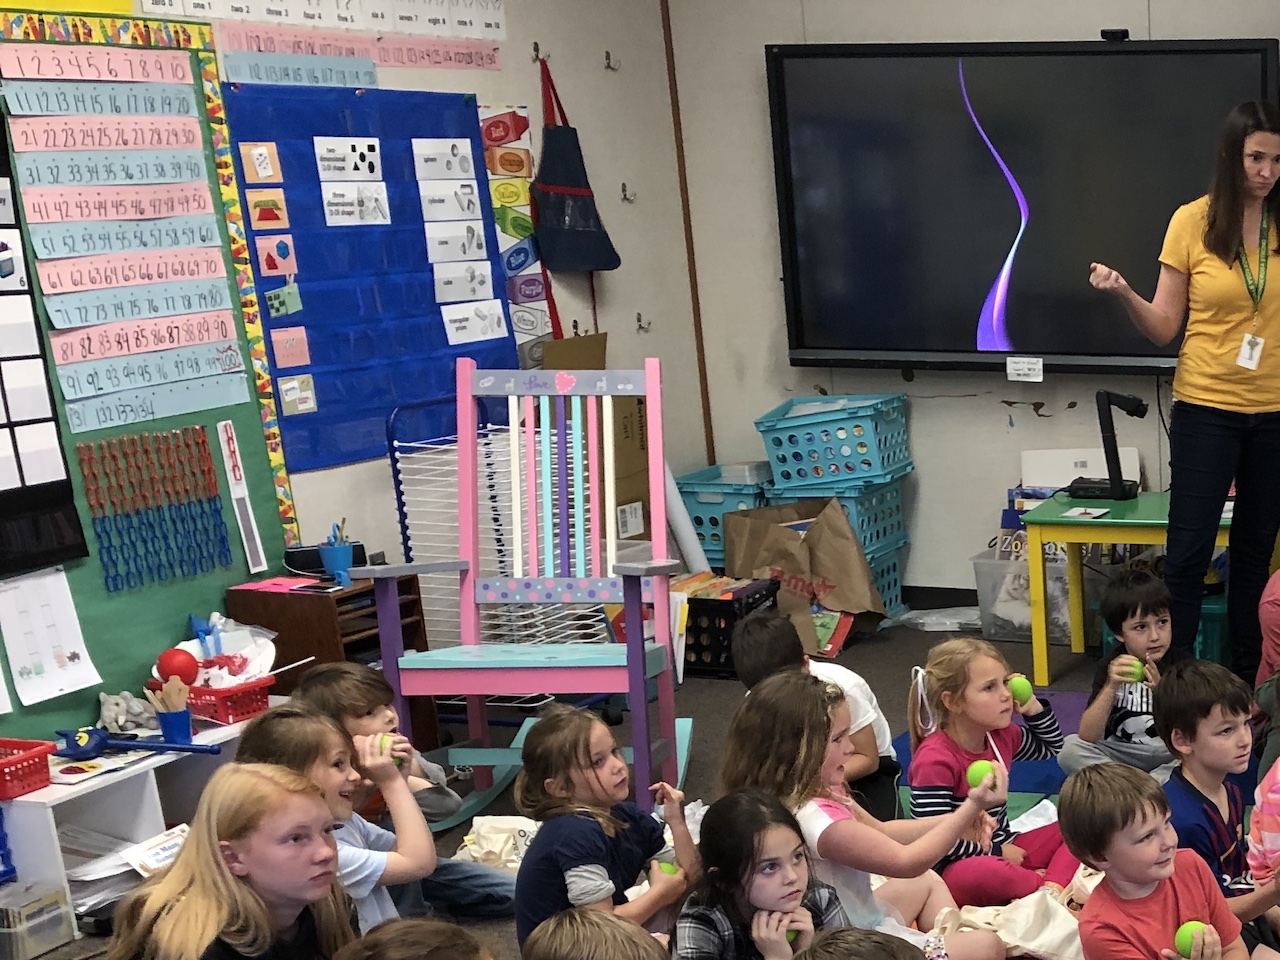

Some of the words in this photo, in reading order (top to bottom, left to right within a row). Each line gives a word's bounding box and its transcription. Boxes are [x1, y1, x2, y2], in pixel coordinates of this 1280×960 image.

[16, 56, 24, 76] 1
[31, 56, 45, 76] 2
[52, 56, 64, 76] 3
[69, 56, 82, 77] 4
[86, 57, 101, 78] 5
[107, 58, 118, 78] 6
[124, 59, 133, 78] 7
[140, 60, 149, 78] 8
[155, 60, 164, 79] 9
[171, 63, 185, 81] 10
[16, 93, 32, 111] 11
[37, 92, 51, 112] 12
[56, 92, 69, 112] 13
[74, 94, 84, 112] 14
[91, 95, 103, 113] 15
[110, 95, 121, 113] 16
[127, 95, 138, 112] 17
[144, 95, 154, 112] 18
[161, 96, 171, 113] 19
[176, 97, 189, 114] 20
[21, 129, 38, 145] 21
[44, 129, 58, 147] 22
[62, 129, 76, 147] 23
[80, 129, 94, 146] 24
[97, 128, 111, 146] 25
[115, 129, 128, 146] 26
[133, 128, 145, 144] 27
[150, 128, 162, 145] 28
[166, 128, 179, 144] 29
[181, 129, 195, 144] 30
[26, 166, 41, 184] 31
[47, 166, 62, 184] 32
[68, 164, 82, 182] 33
[85, 164, 99, 181] 34
[103, 164, 116, 181] 35
[120, 164, 133, 180] 36
[136, 164, 149, 179] 37
[153, 163, 166, 178] 38
[171, 162, 181, 178] 39
[186, 162, 200, 178] 40
[33, 202, 48, 220] 41
[54, 201, 73, 218] 42
[76, 200, 90, 217] 43
[94, 200, 107, 217] 44
[112, 200, 127, 215] 45
[131, 201, 145, 215] 46
[150, 200, 161, 214] 47
[164, 199, 175, 211] 48
[178, 199, 190, 212] 49
[193, 196, 206, 210] 50
[20, 277, 25, 286] 6
[96, 403, 114, 420] 132
[116, 401, 134, 420] 133
